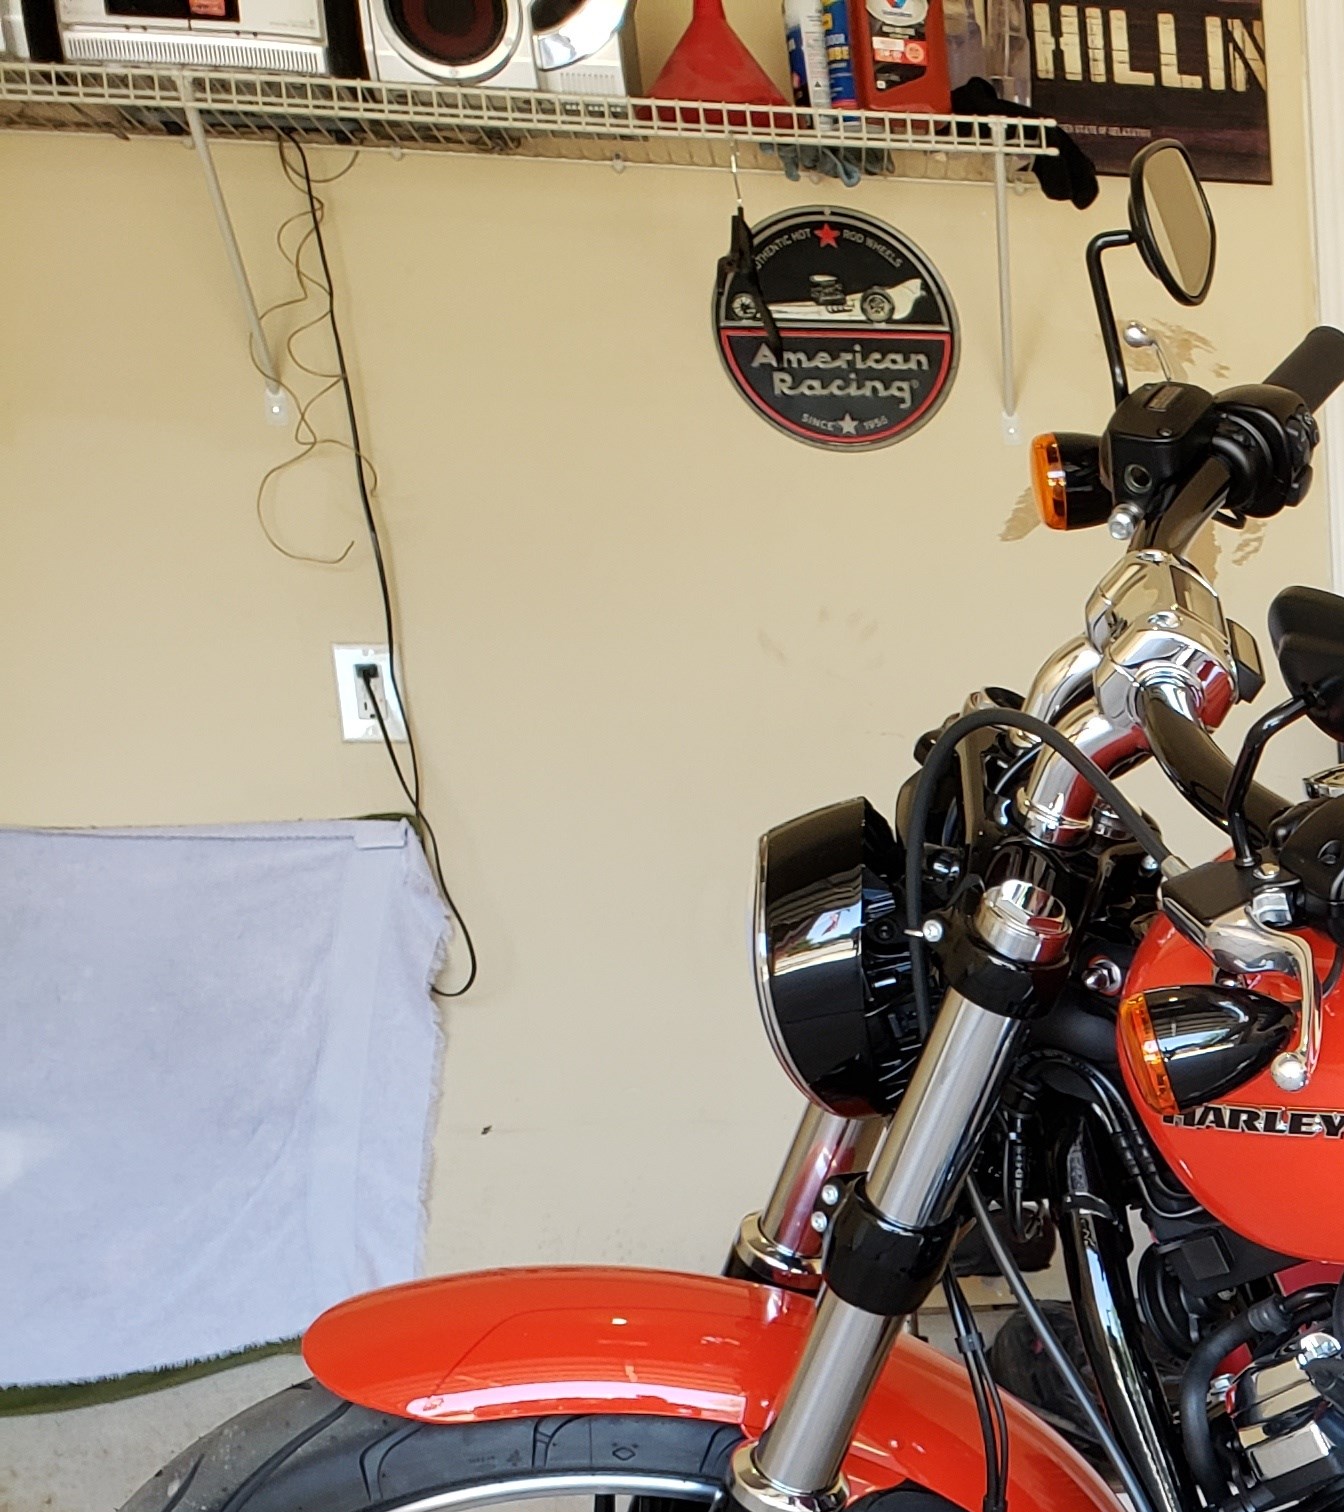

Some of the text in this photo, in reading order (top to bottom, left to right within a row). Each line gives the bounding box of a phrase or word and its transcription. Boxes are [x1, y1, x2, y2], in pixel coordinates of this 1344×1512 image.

[792, 228, 812, 242] HOT
[842, 229, 865, 243] ROD
[865, 236, 904, 269] WHEELS
[751, 342, 930, 371] American
[772, 370, 913, 410] Racing
[801, 412, 836, 432] SINCE
